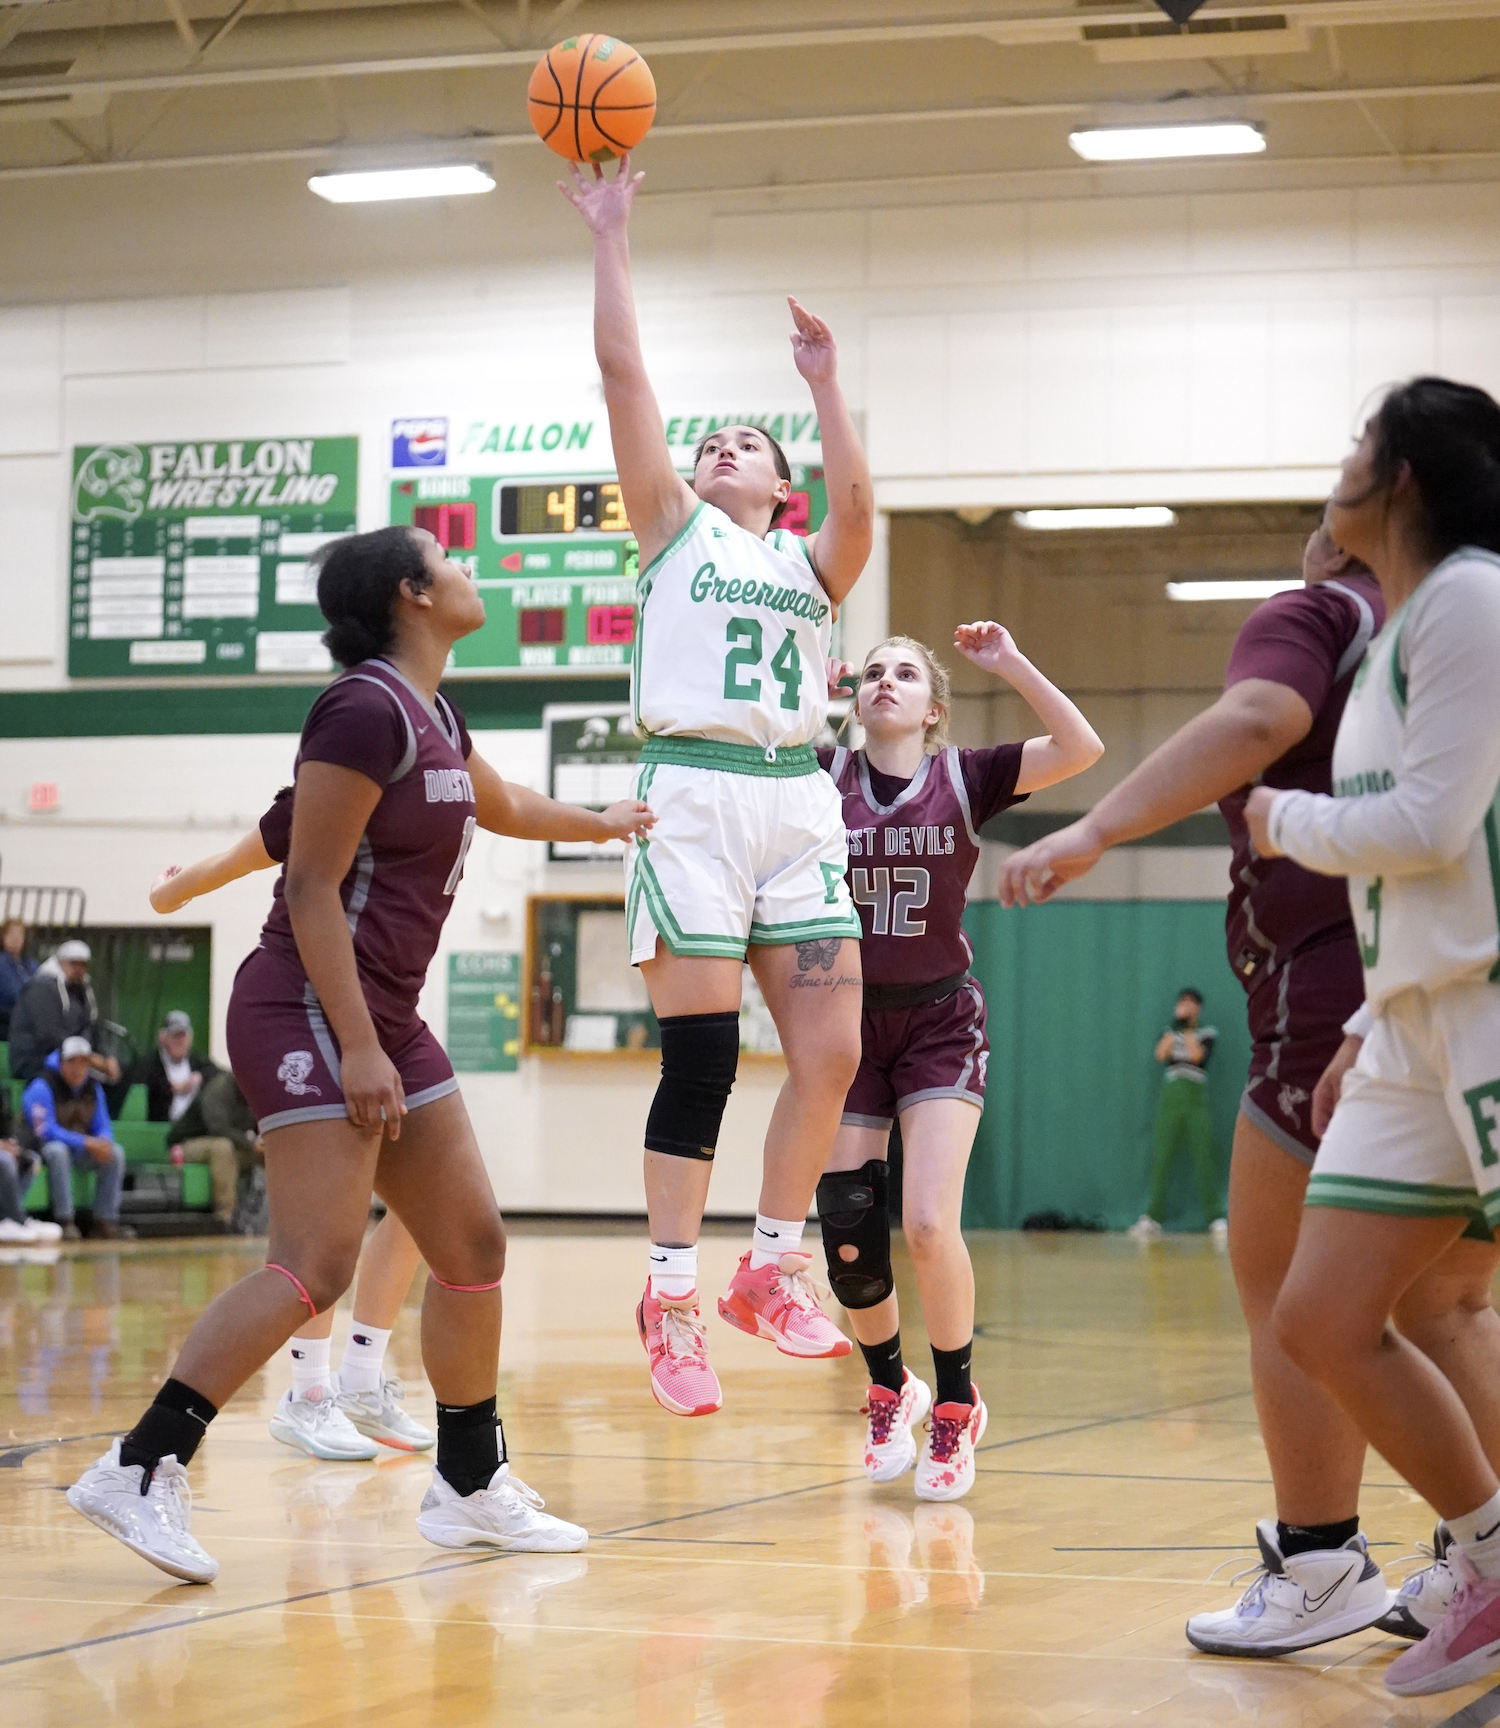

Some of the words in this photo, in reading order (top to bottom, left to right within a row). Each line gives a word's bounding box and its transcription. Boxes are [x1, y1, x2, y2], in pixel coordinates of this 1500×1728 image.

[459, 421, 593, 454] FALLON
[665, 413, 821, 446] EENAV
[149, 440, 314, 479] FALLON
[147, 473, 338, 509] WRESTLING
[690, 561, 829, 628] Greenwave
[588, 605, 634, 645] 05
[723, 616, 803, 711] 24
[846, 827, 876, 856] ST
[884, 826, 955, 856] DEVILS
[852, 867, 931, 937] 42
